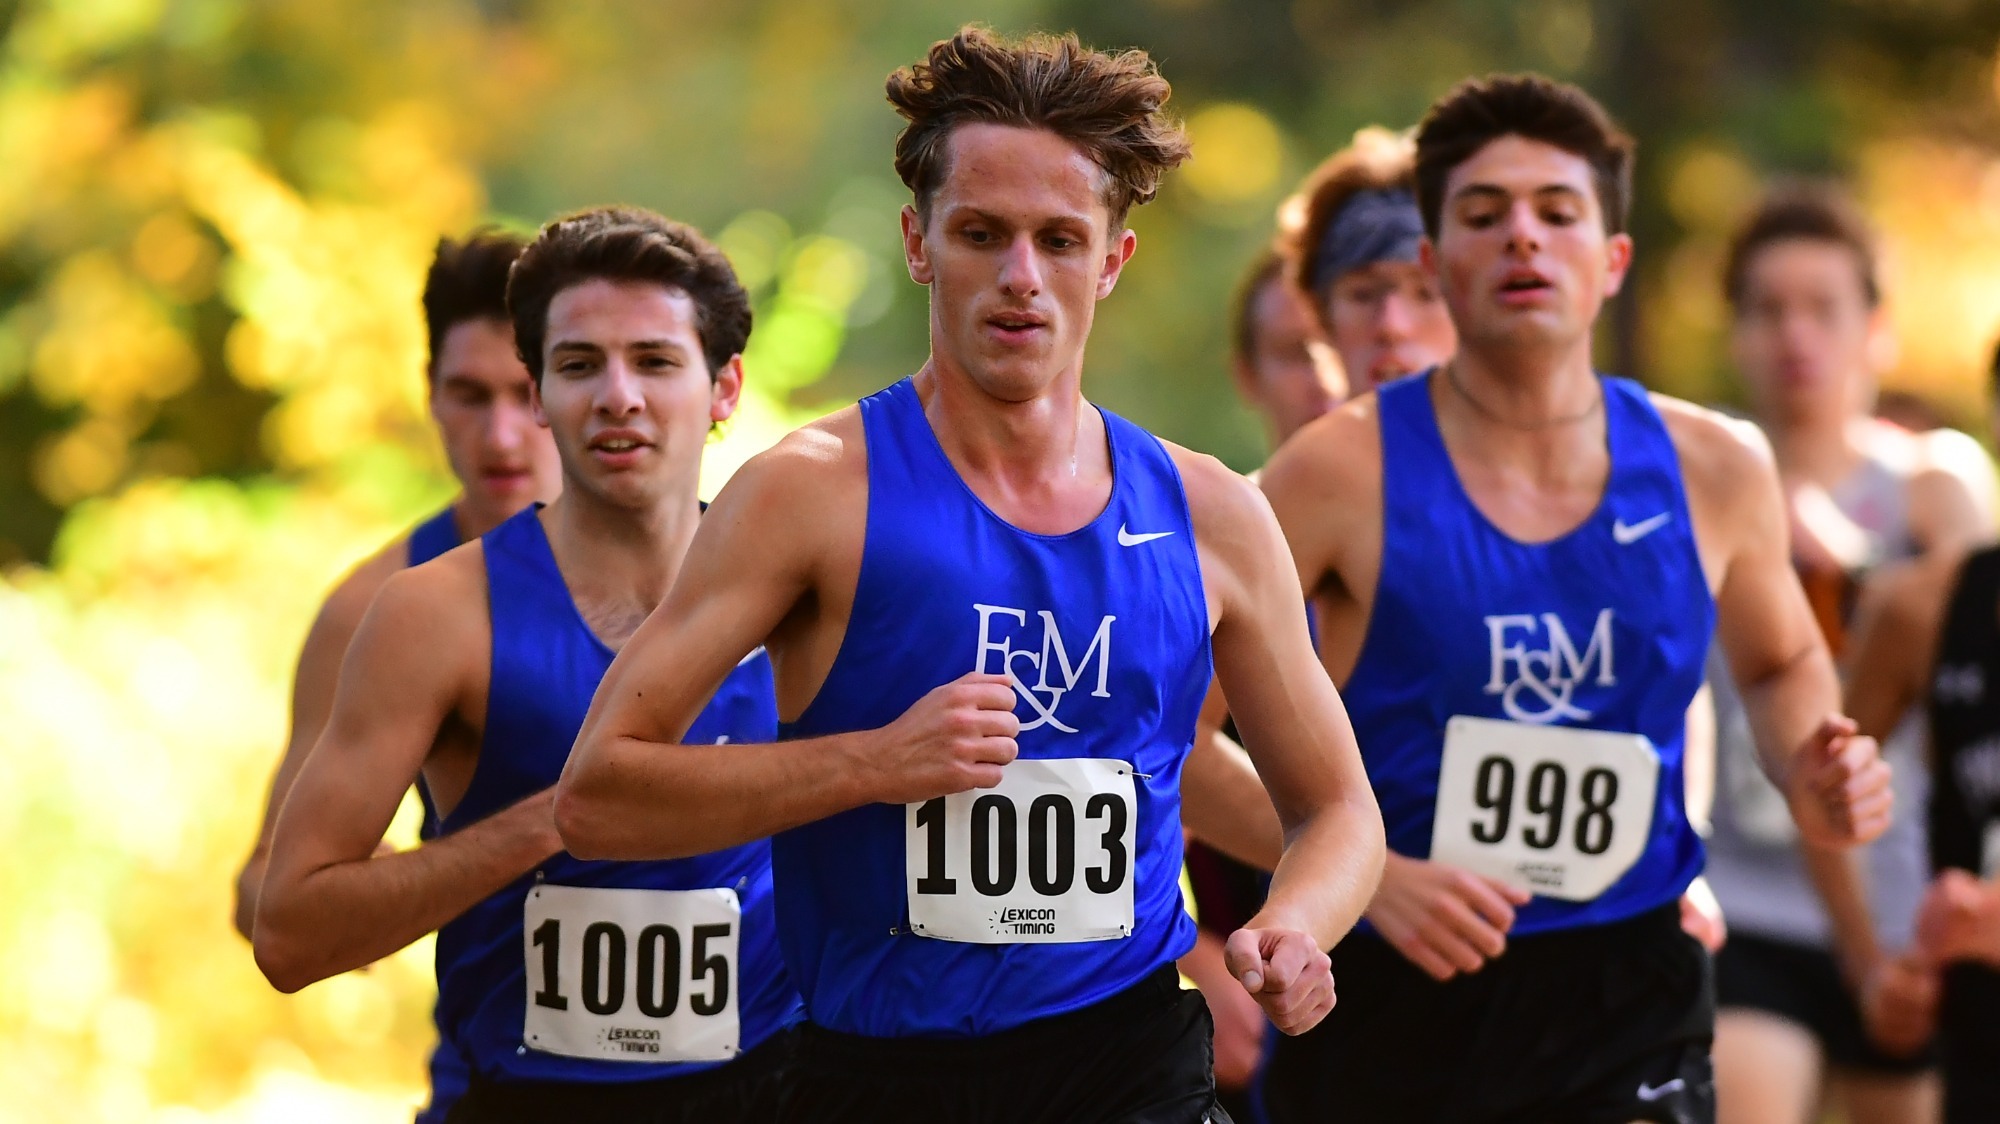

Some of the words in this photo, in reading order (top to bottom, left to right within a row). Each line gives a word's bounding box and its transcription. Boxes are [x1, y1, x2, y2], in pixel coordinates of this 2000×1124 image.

[973, 603, 1116, 734] F&M
[1484, 608, 1616, 724] F&M
[916, 793, 1127, 897] 1003
[1471, 757, 1618, 855] 998
[1000, 907, 1056, 924] LEXICON
[1008, 923, 1056, 935] TIMING
[533, 918, 732, 1018] 1005
